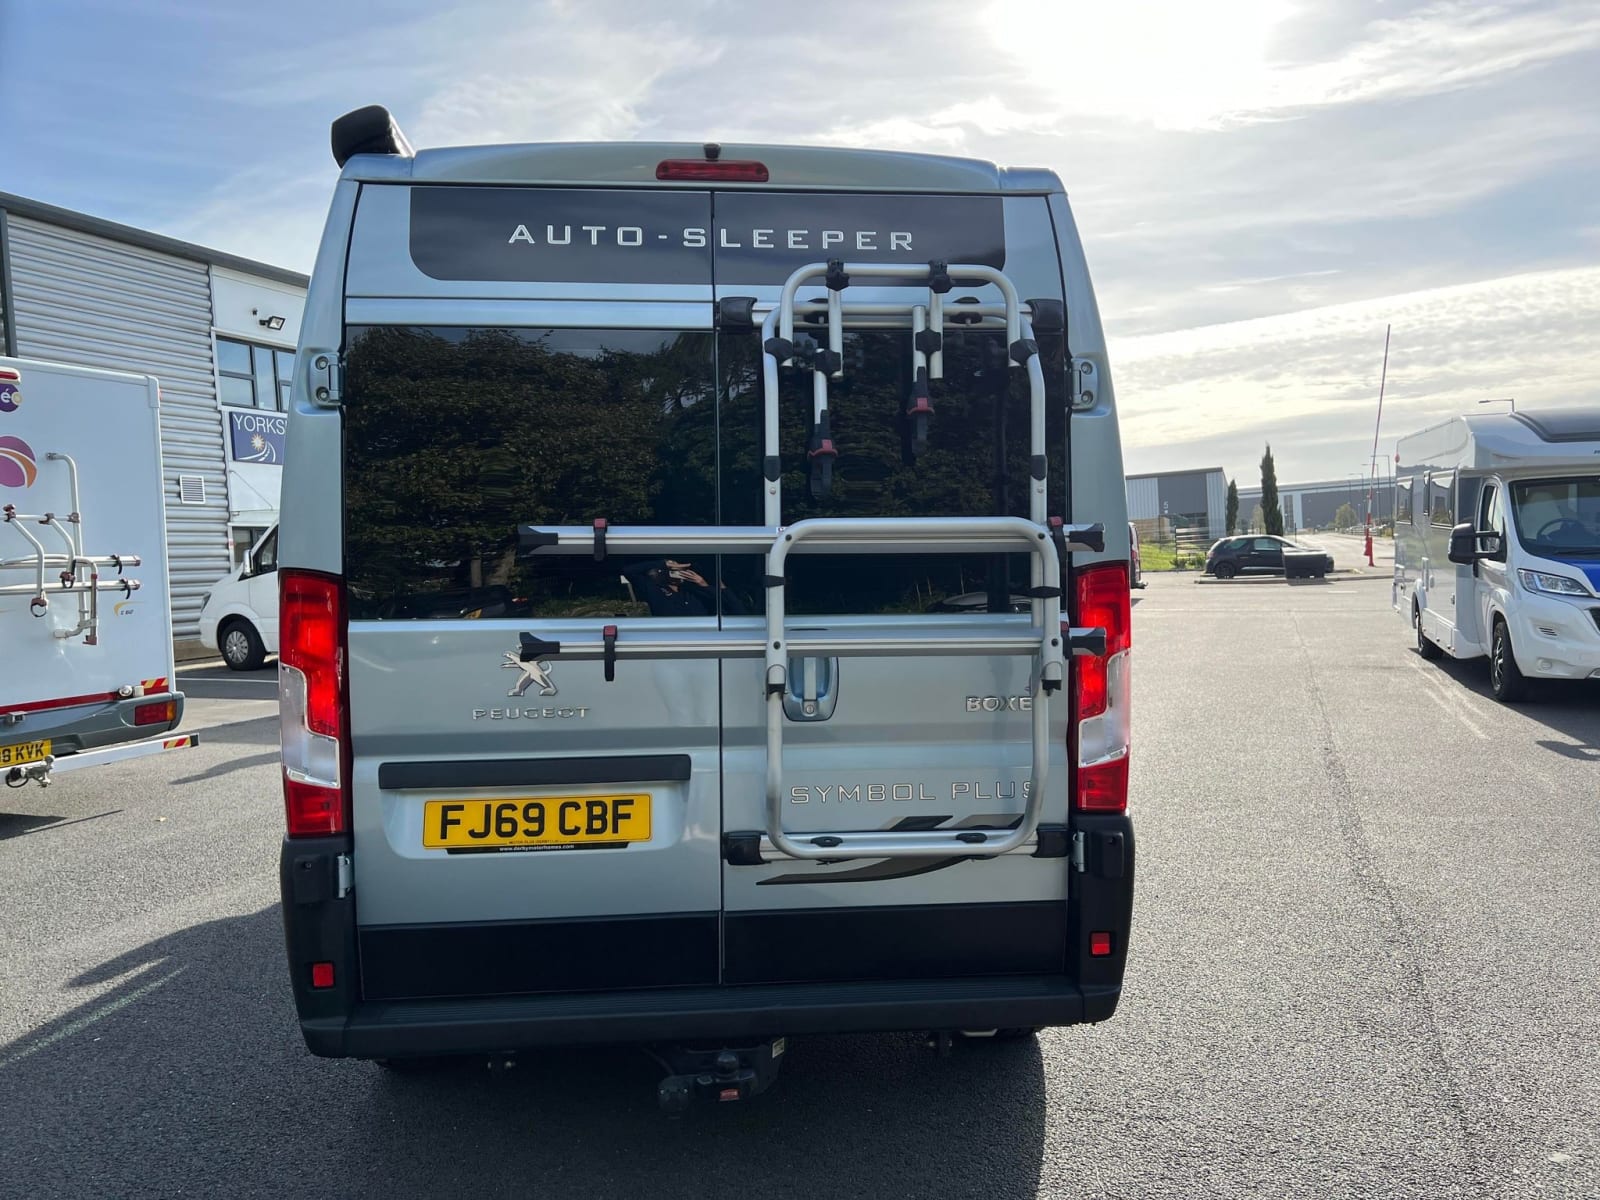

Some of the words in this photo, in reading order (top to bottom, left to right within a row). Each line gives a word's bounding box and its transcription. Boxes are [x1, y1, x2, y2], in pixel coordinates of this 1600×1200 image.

[233, 413, 287, 435] YORKS
[472, 706, 591, 720] PEUGEOT
[966, 696, 1033, 712] BOXE
[15, 742, 45, 761] KVK
[790, 784, 937, 804] SYMBOL
[439, 802, 546, 840] FJ69
[558, 799, 635, 836] CBF
